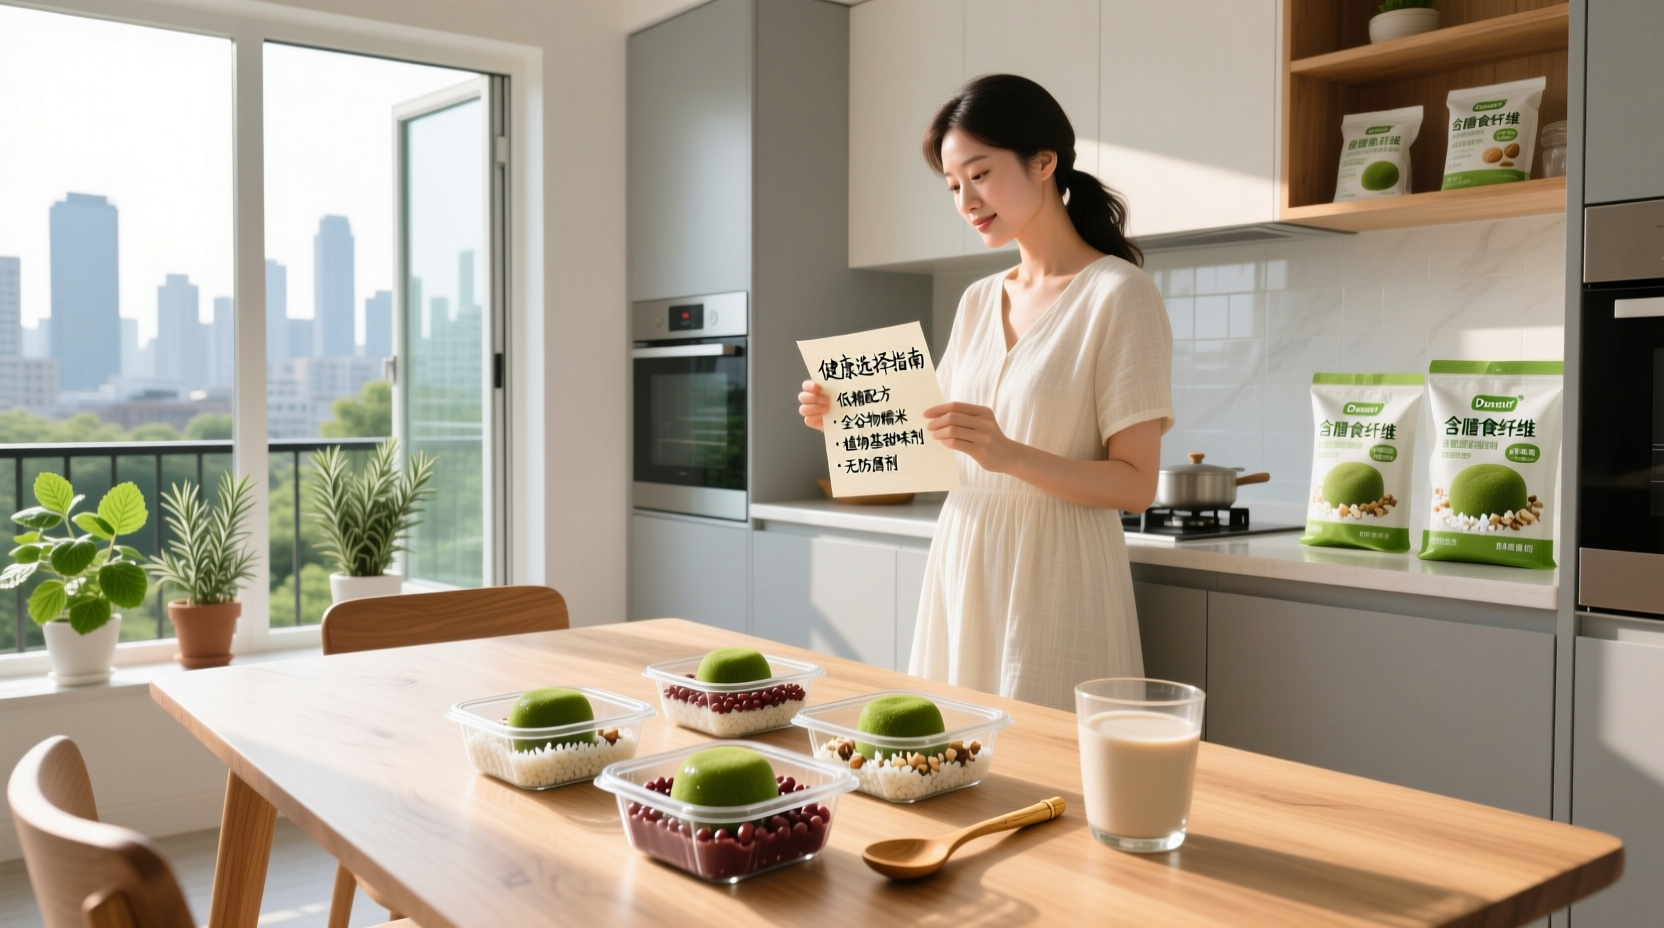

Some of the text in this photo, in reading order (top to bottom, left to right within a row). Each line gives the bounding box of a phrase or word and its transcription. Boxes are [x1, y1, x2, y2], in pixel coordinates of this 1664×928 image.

[818, 346, 924, 381] 健康选择指南
